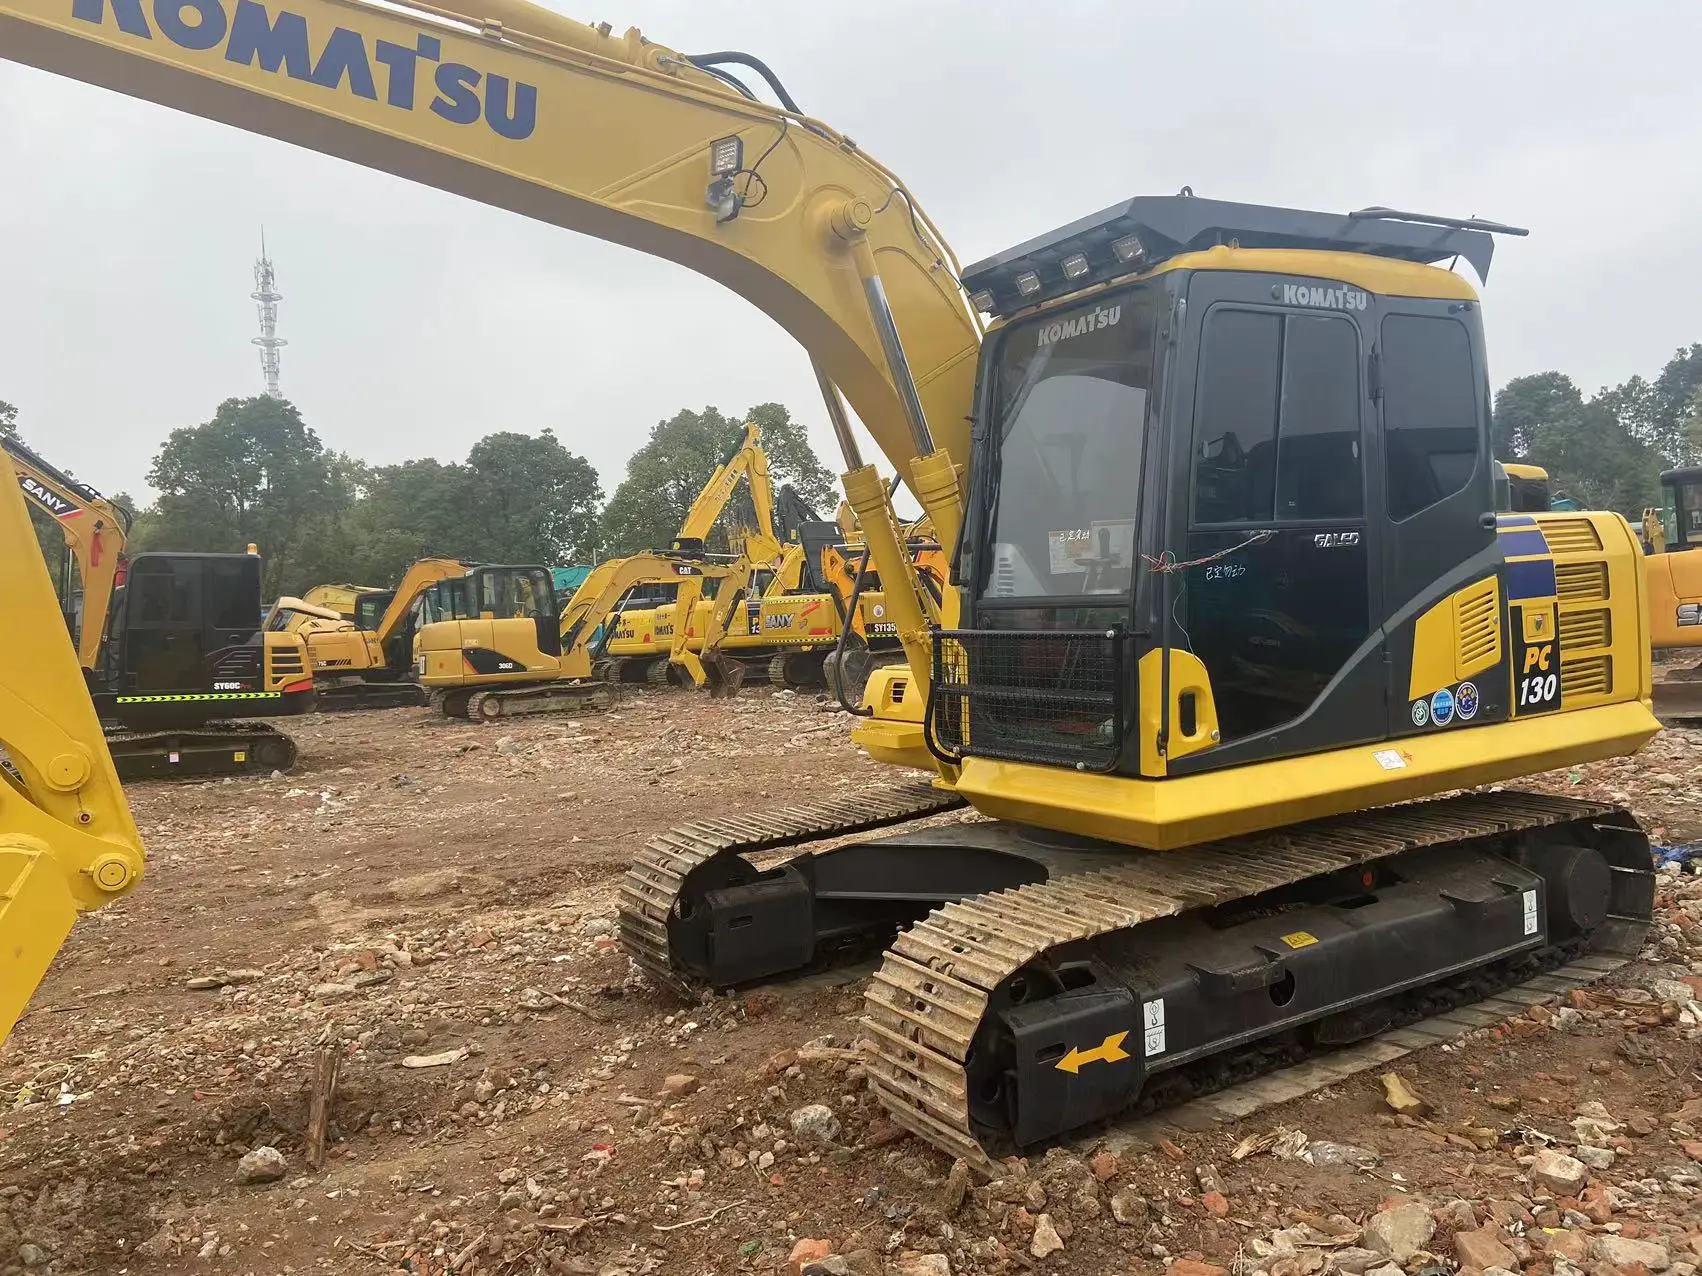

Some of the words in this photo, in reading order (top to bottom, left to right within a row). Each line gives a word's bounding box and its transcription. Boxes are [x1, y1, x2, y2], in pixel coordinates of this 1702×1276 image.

[1282, 283, 1367, 311] KOMATSU
[1036, 305, 1121, 347] KOMATSU
[22, 478, 67, 511] SANY
[679, 566, 691, 575] CAT
[765, 613, 796, 629] SANY
[874, 623, 896, 632] SY135
[1677, 601, 1702, 627] S
[1523, 644, 1552, 674] PC
[1520, 674, 1557, 706] 130
